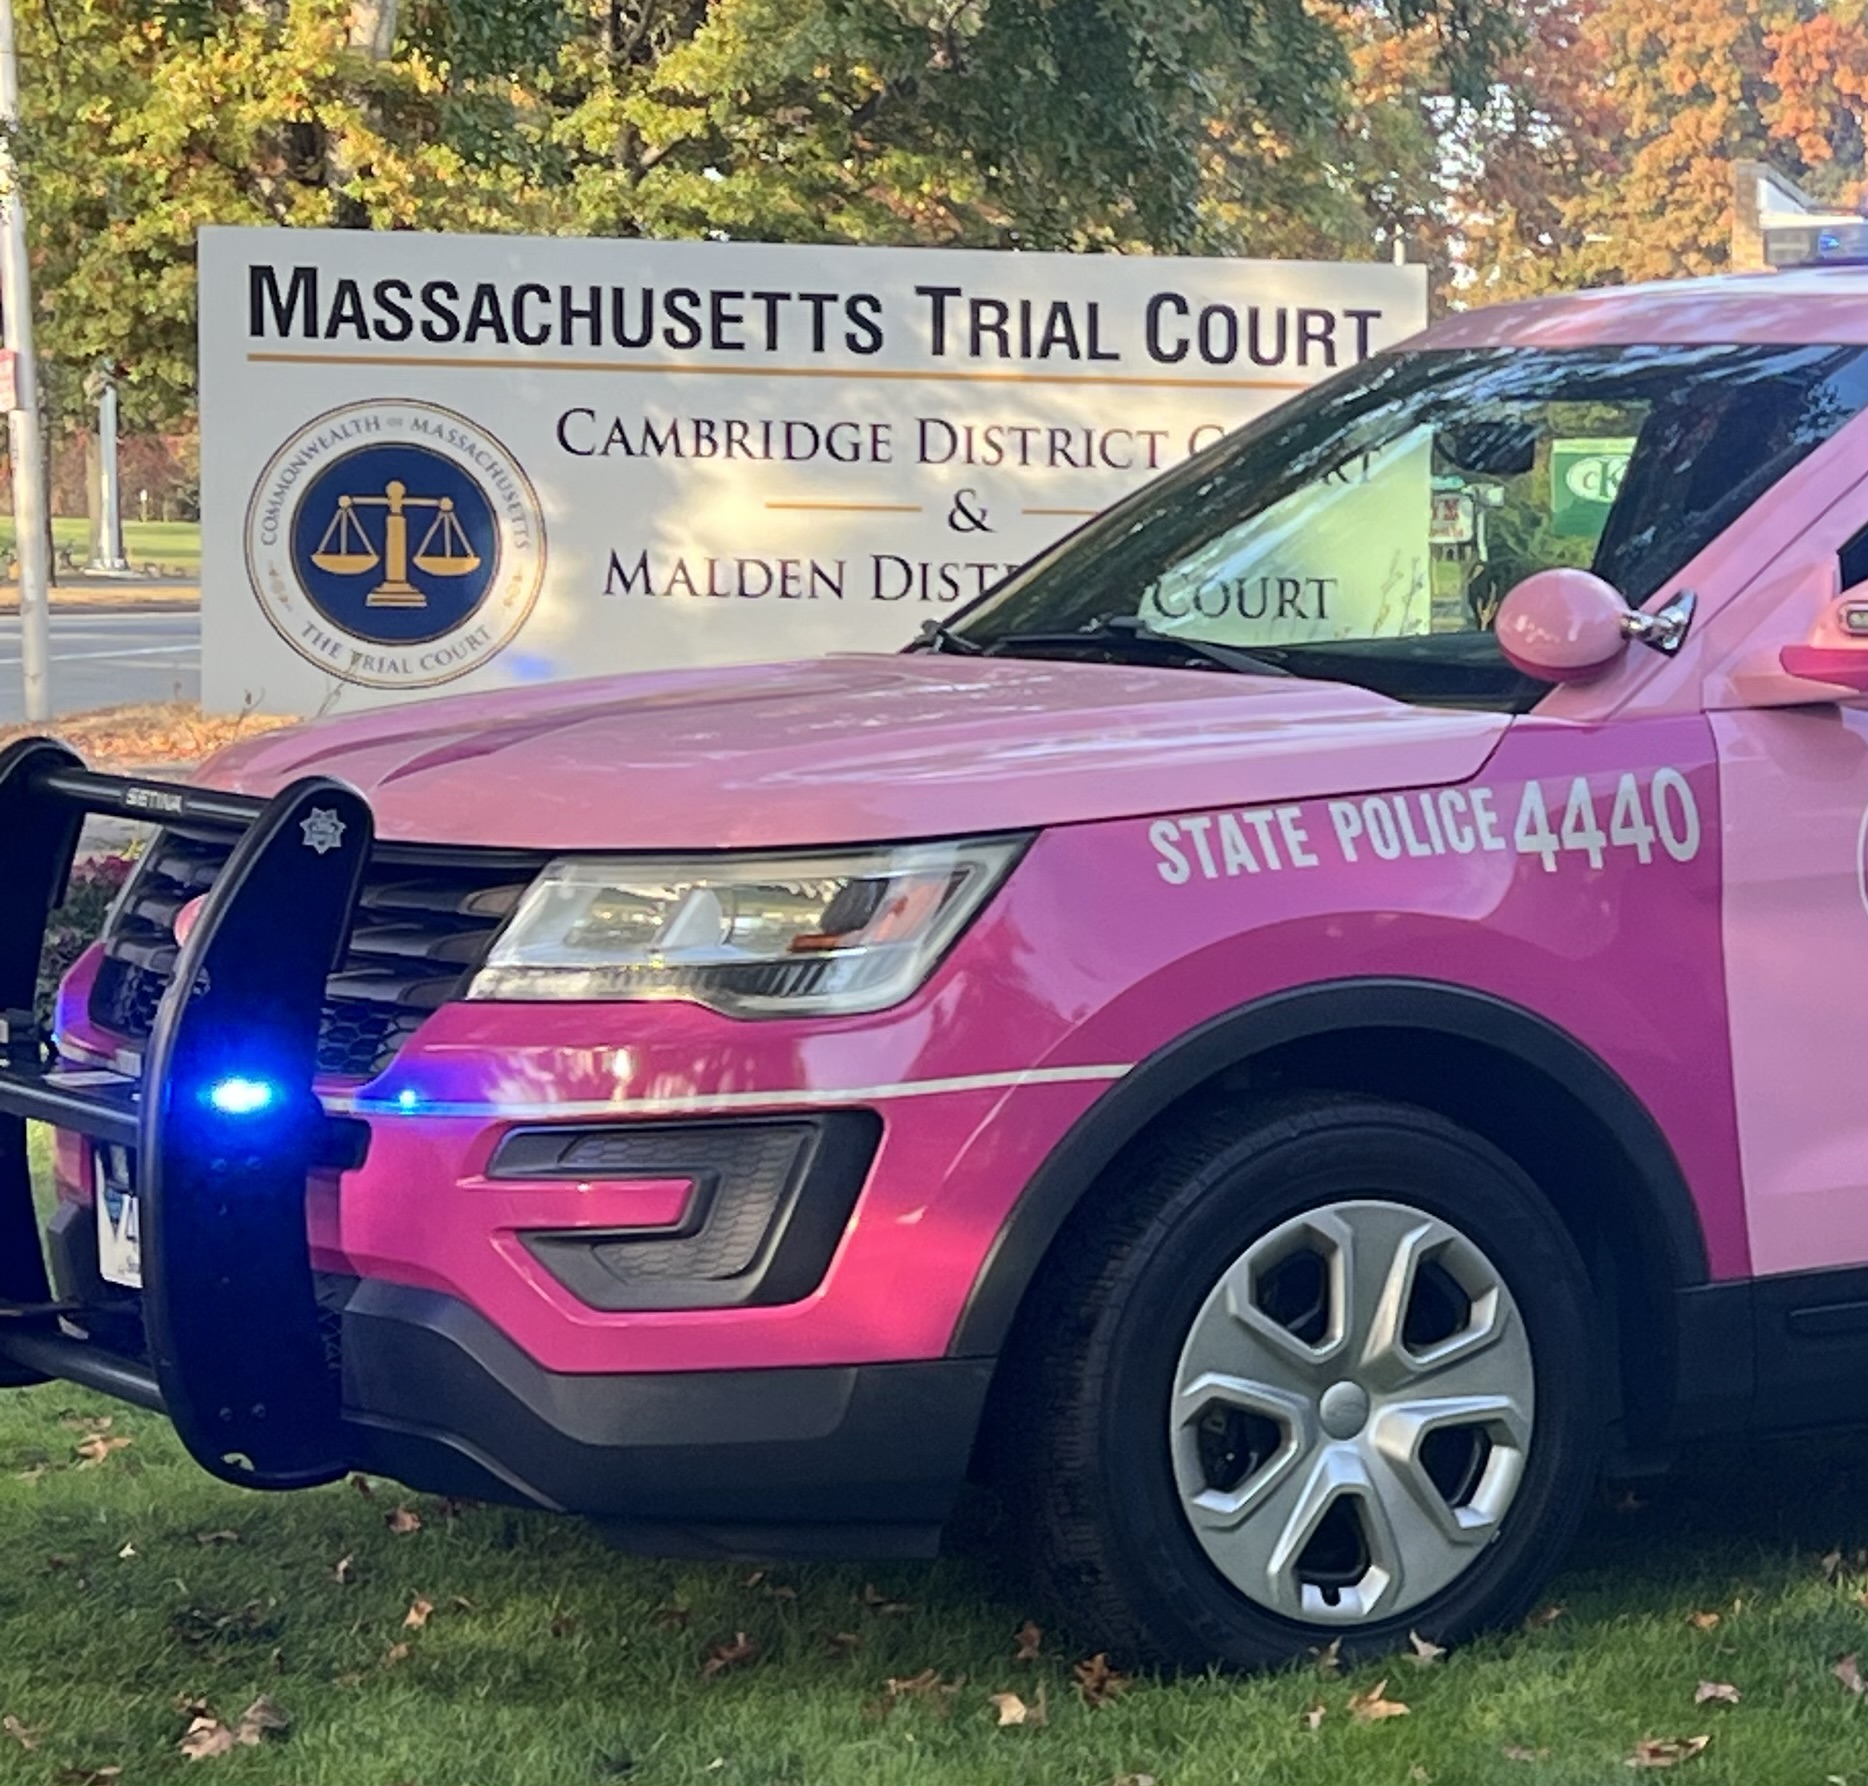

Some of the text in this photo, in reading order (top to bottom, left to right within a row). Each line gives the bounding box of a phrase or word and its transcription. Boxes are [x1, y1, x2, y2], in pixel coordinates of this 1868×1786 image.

[247, 264, 1382, 367] MASSACHUSETTS TRIAL COURT
[556, 407, 894, 464] CAMBRIDGE
[914, 416, 1170, 471] DISTRICT
[260, 415, 382, 546] COMMONWEALTH
[410, 417, 530, 549] MASSACHUSETTS
[948, 488, 997, 533] &
[602, 548, 1337, 620] MALDEN DIST COURT
[300, 621, 494, 675] THE TRIAL COURT
[1148, 767, 1701, 886] STATE POLICE 4440
